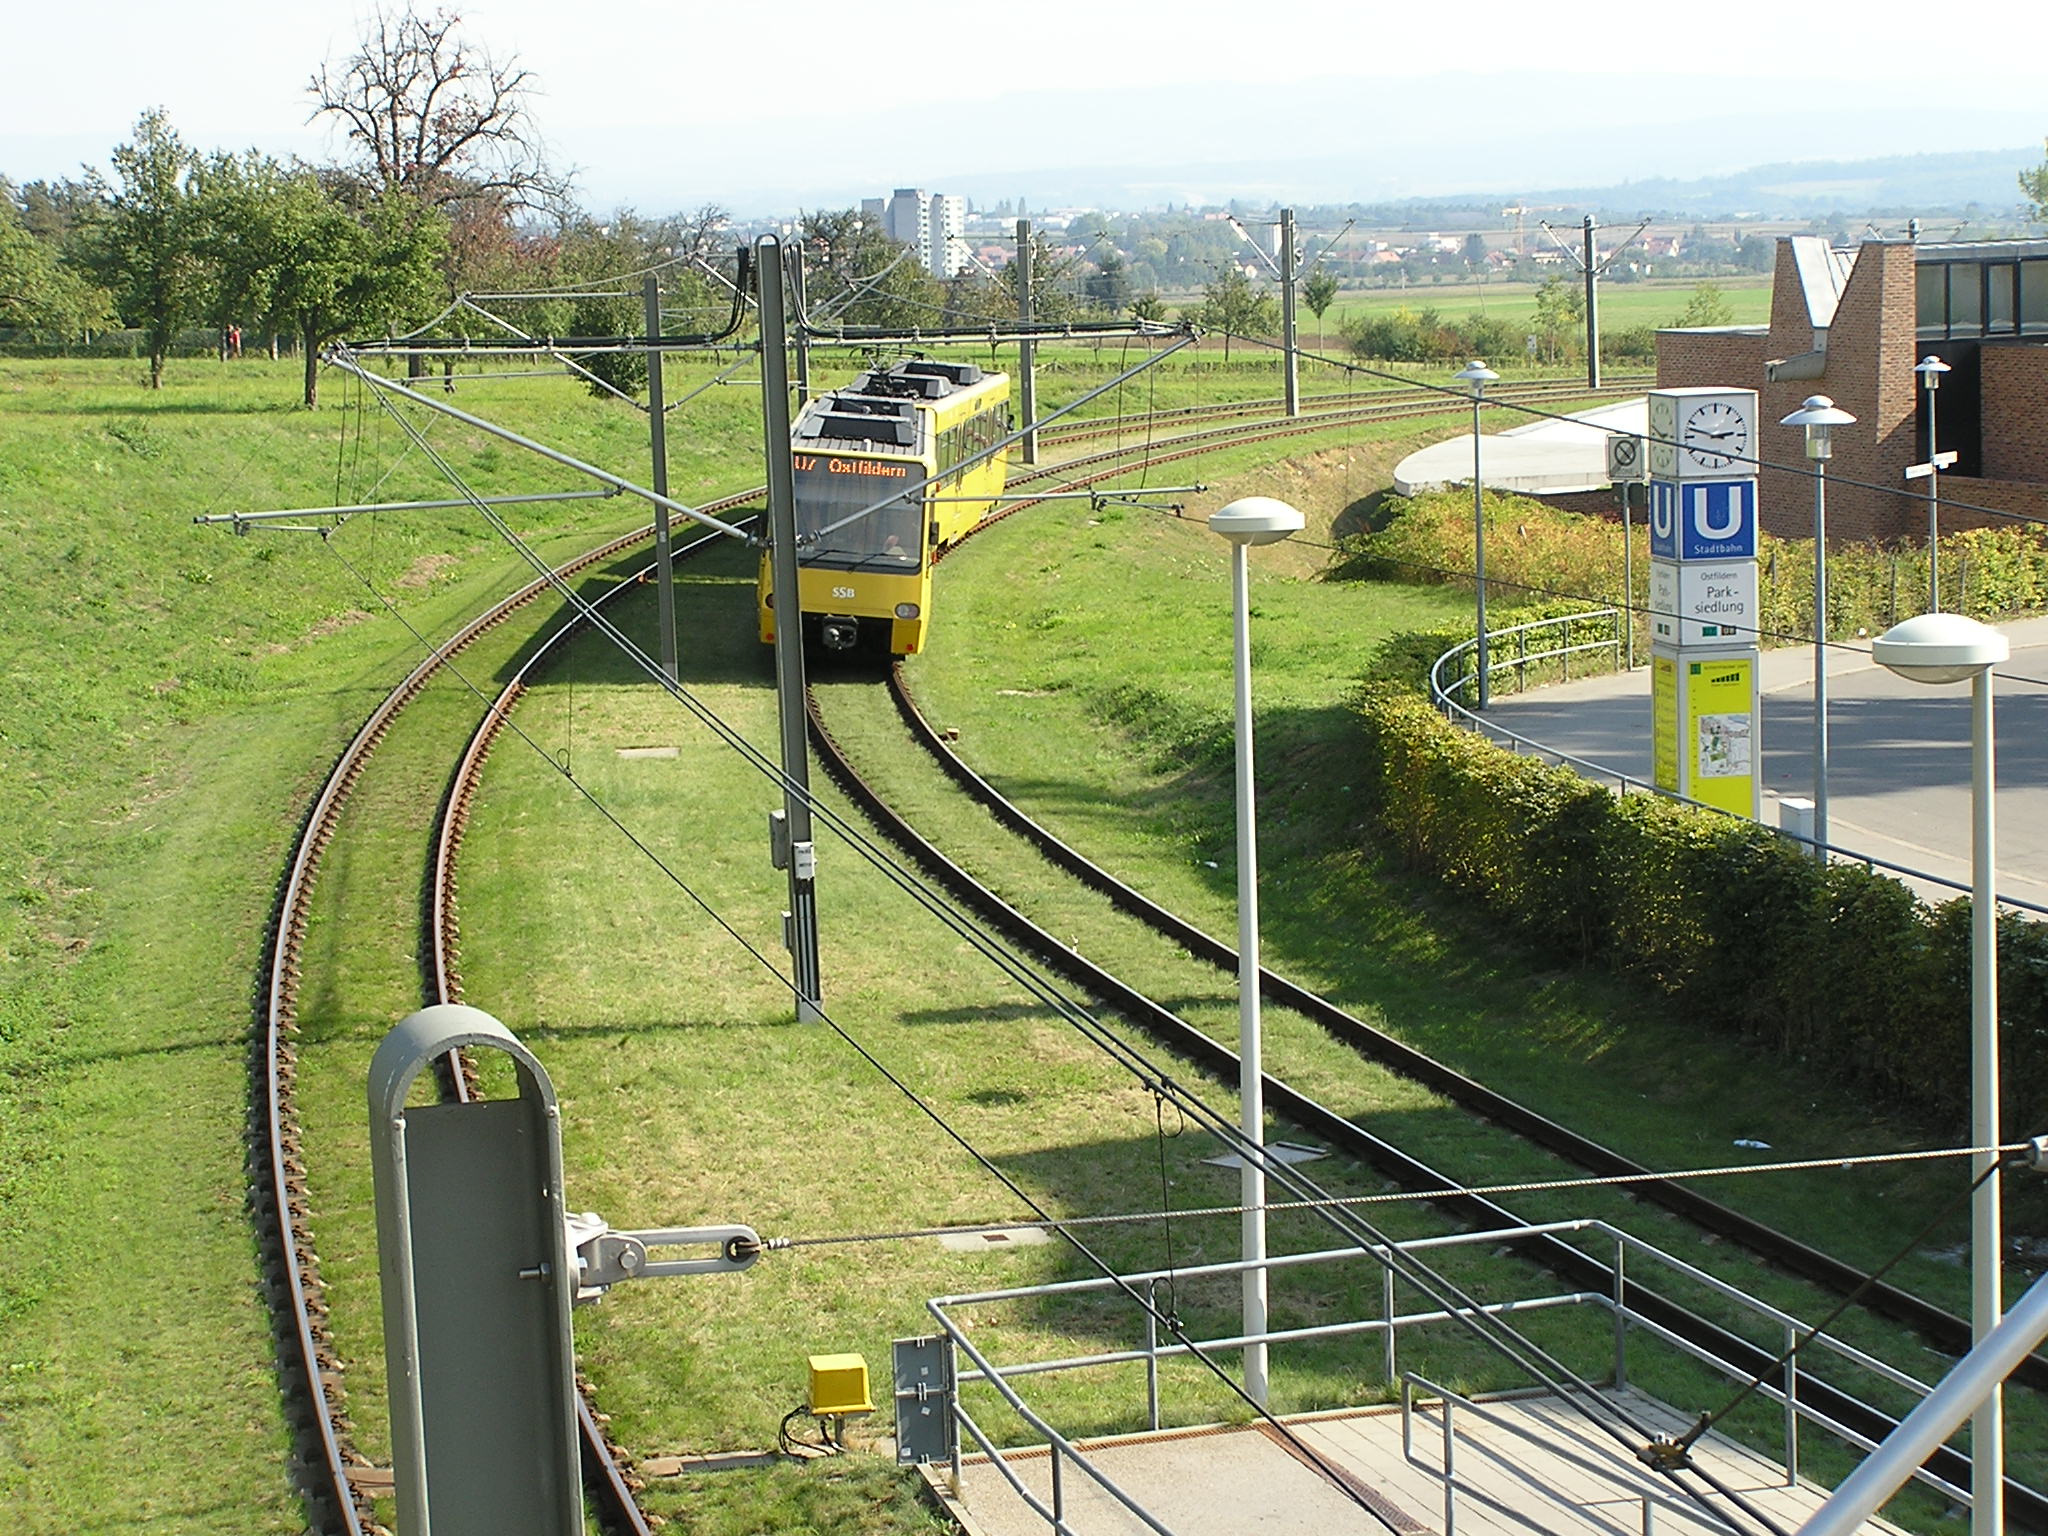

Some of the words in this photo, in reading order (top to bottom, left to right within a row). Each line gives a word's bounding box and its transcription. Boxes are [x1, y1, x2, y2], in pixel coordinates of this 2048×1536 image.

[1653, 485, 1671, 539] U
[1694, 487, 1742, 540] U
[1694, 544, 1744, 555] Stadtbahn
[1700, 571, 1738, 581] Ostfildern
[832, 587, 855, 599] SSB
[1707, 586, 1740, 599] Park-
[1695, 601, 1745, 615] siedlung
